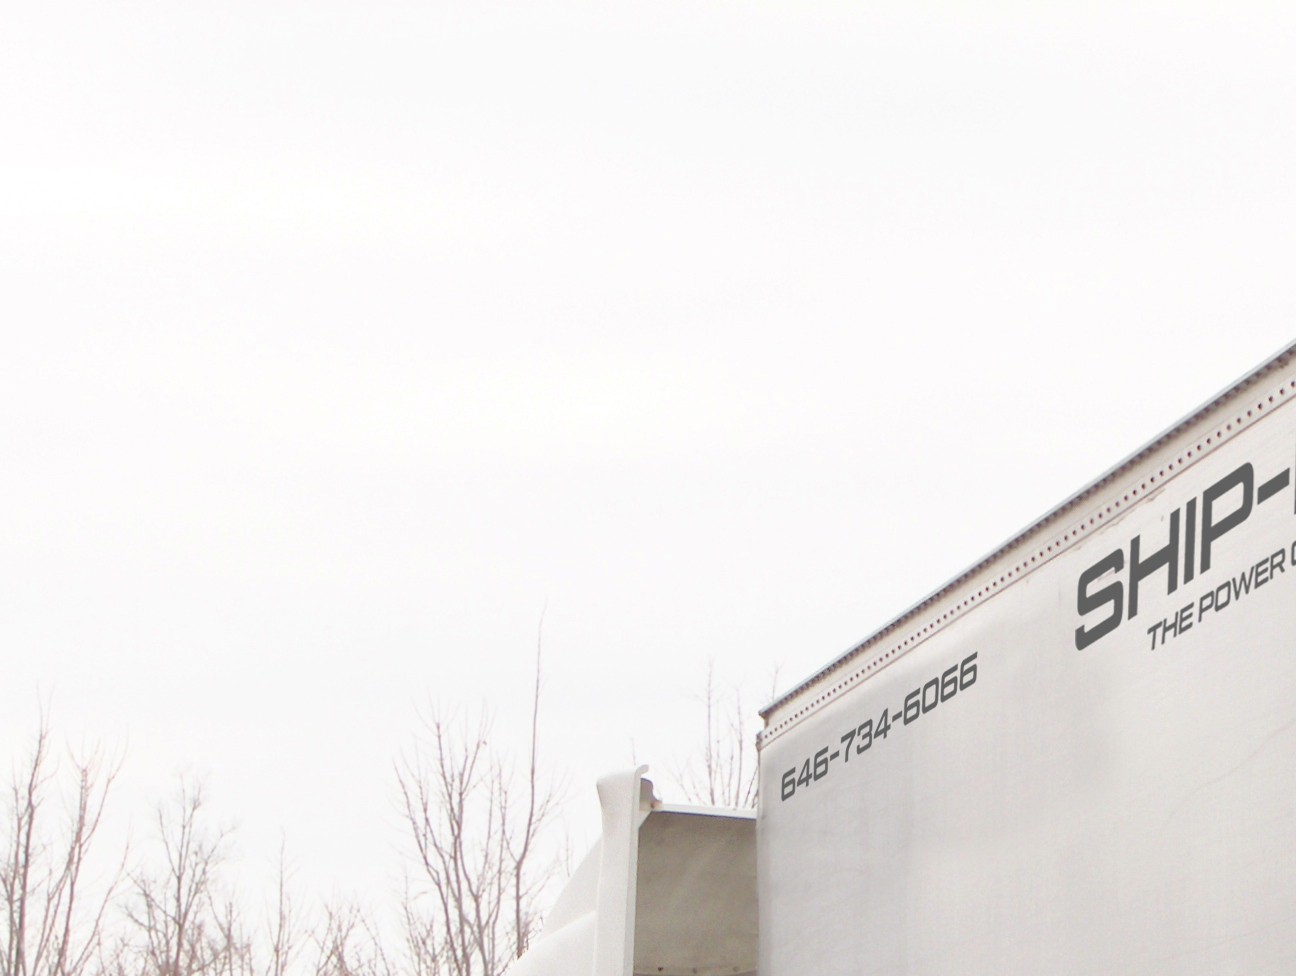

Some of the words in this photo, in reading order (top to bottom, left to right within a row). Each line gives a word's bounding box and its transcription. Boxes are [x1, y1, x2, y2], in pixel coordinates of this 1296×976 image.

[1147, 602, 1195, 650] THE
[1198, 549, 1286, 623] POWER
[781, 651, 978, 801] 646-734-6066
